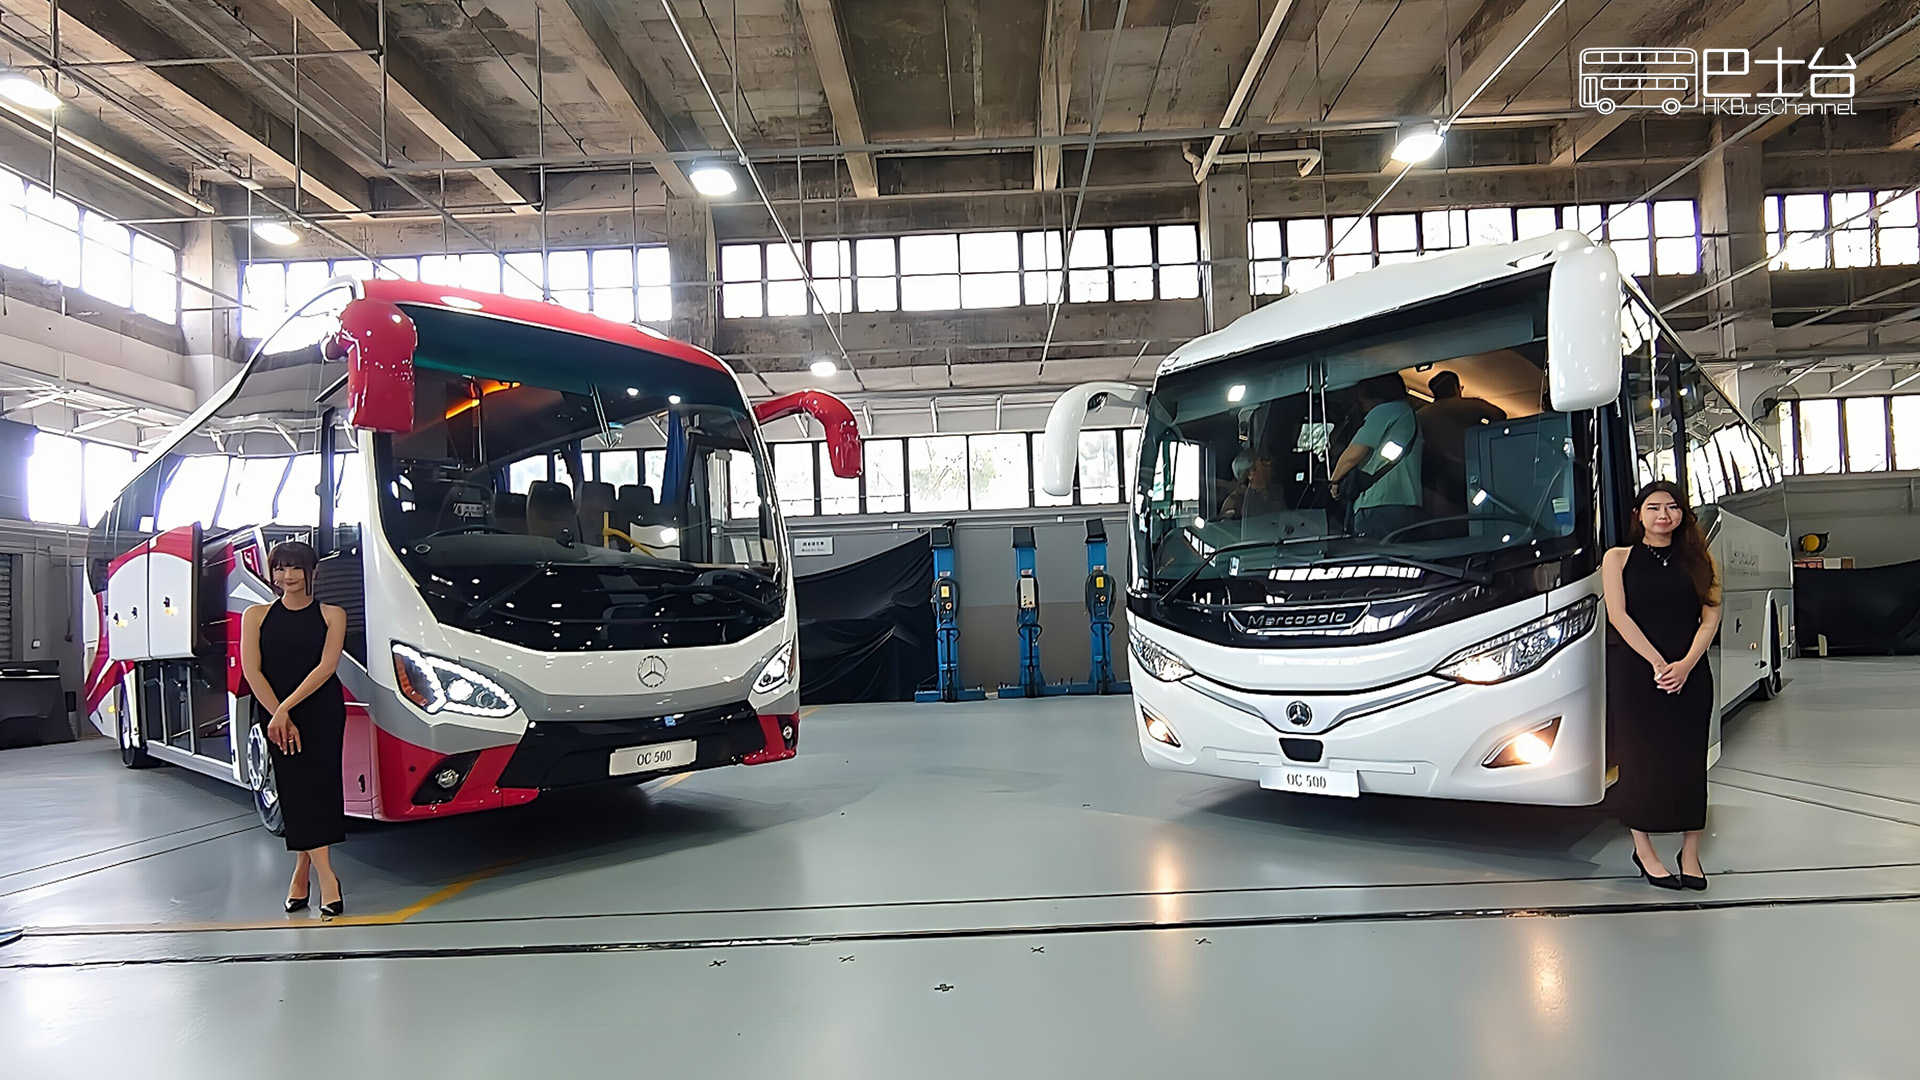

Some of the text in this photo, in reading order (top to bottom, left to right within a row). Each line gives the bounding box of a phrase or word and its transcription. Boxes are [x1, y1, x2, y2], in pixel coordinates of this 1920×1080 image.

[637, 750, 672, 766] OC 500
[1287, 773, 1327, 789] OC 500
